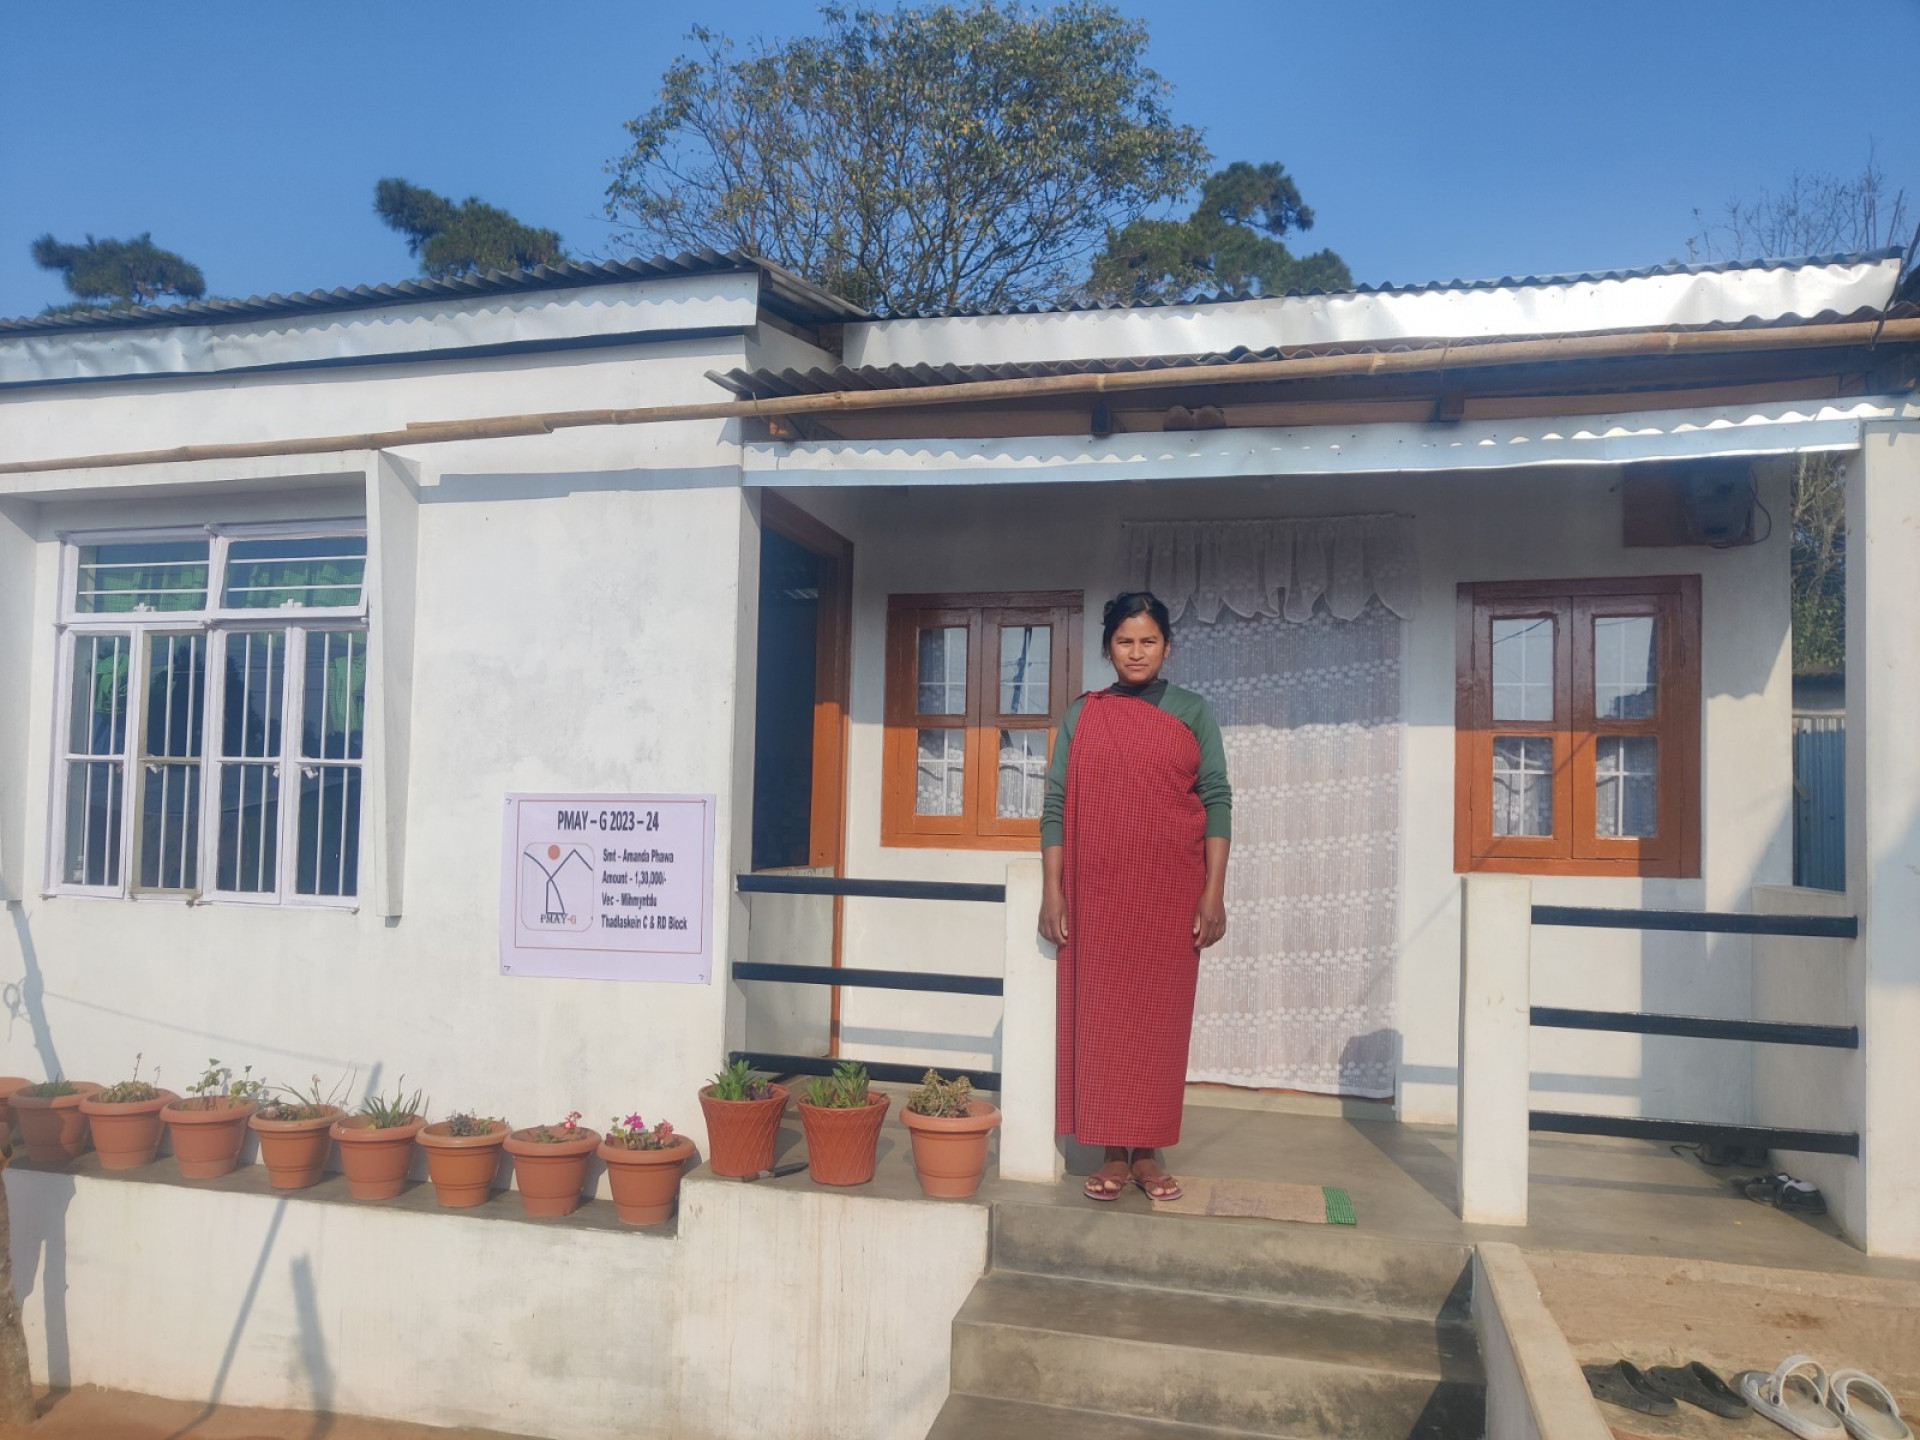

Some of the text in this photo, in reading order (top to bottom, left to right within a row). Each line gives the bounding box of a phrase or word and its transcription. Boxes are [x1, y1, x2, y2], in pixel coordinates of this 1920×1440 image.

[557, 810, 589, 831] PMAY
[599, 810, 608, 832] G
[609, 810, 635, 832] 2023
[646, 811, 660, 832] 24
[603, 848, 616, 862] Smt
[622, 848, 650, 863] Amanda
[651, 848, 674, 864] Phawa
[602, 870, 628, 884] Amount
[601, 892, 615, 906] Vec
[621, 892, 657, 910] Mihmyntdu
[601, 914, 688, 931] Thadlaskein C & RD Block
